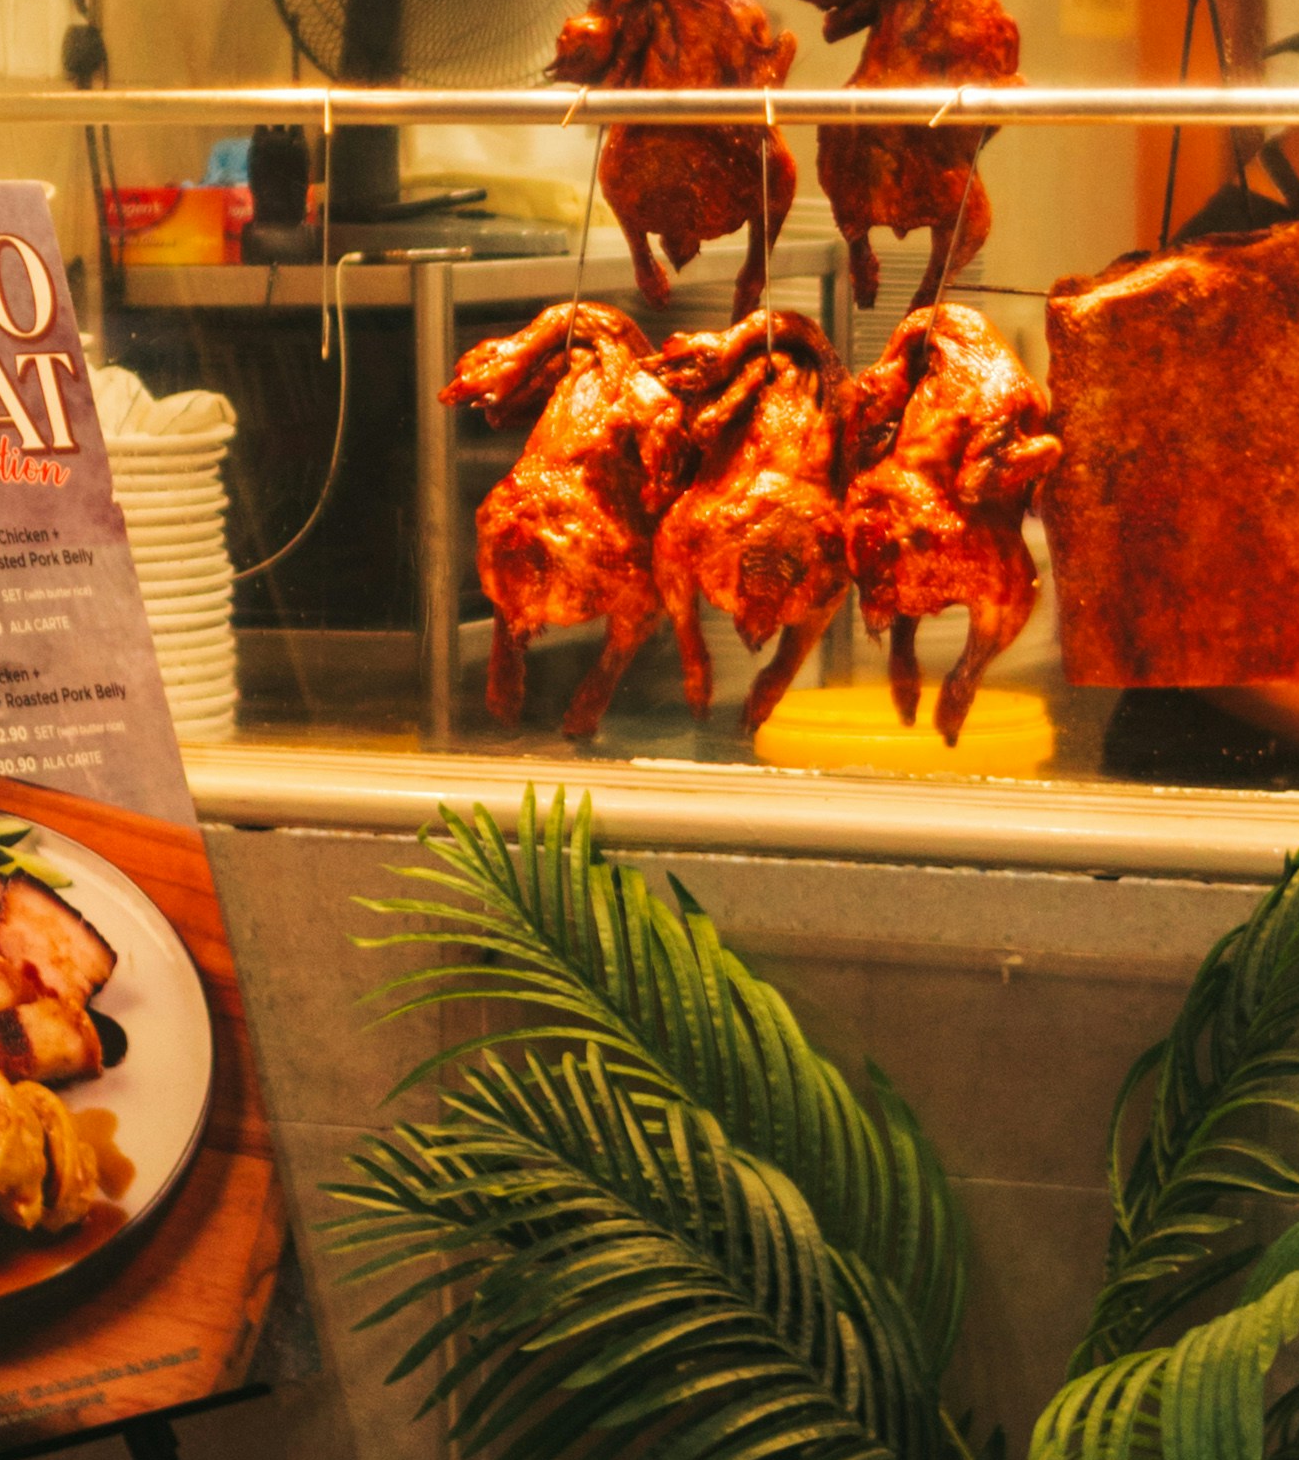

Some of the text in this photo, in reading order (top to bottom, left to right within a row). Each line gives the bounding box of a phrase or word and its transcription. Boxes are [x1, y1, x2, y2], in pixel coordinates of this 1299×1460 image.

[30, 550, 60, 567] Pork
[63, 548, 94, 567] Belly
[1, 589, 22, 603] SET
[10, 618, 33, 633] ALA
[33, 615, 70, 631] CARTE
[5, 690, 58, 709] Roasted
[62, 685, 93, 702] Pork
[95, 682, 126, 700] Belly
[34, 725, 54, 740] SET
[42, 755, 65, 770] ALA
[66, 750, 102, 767] CARTE
